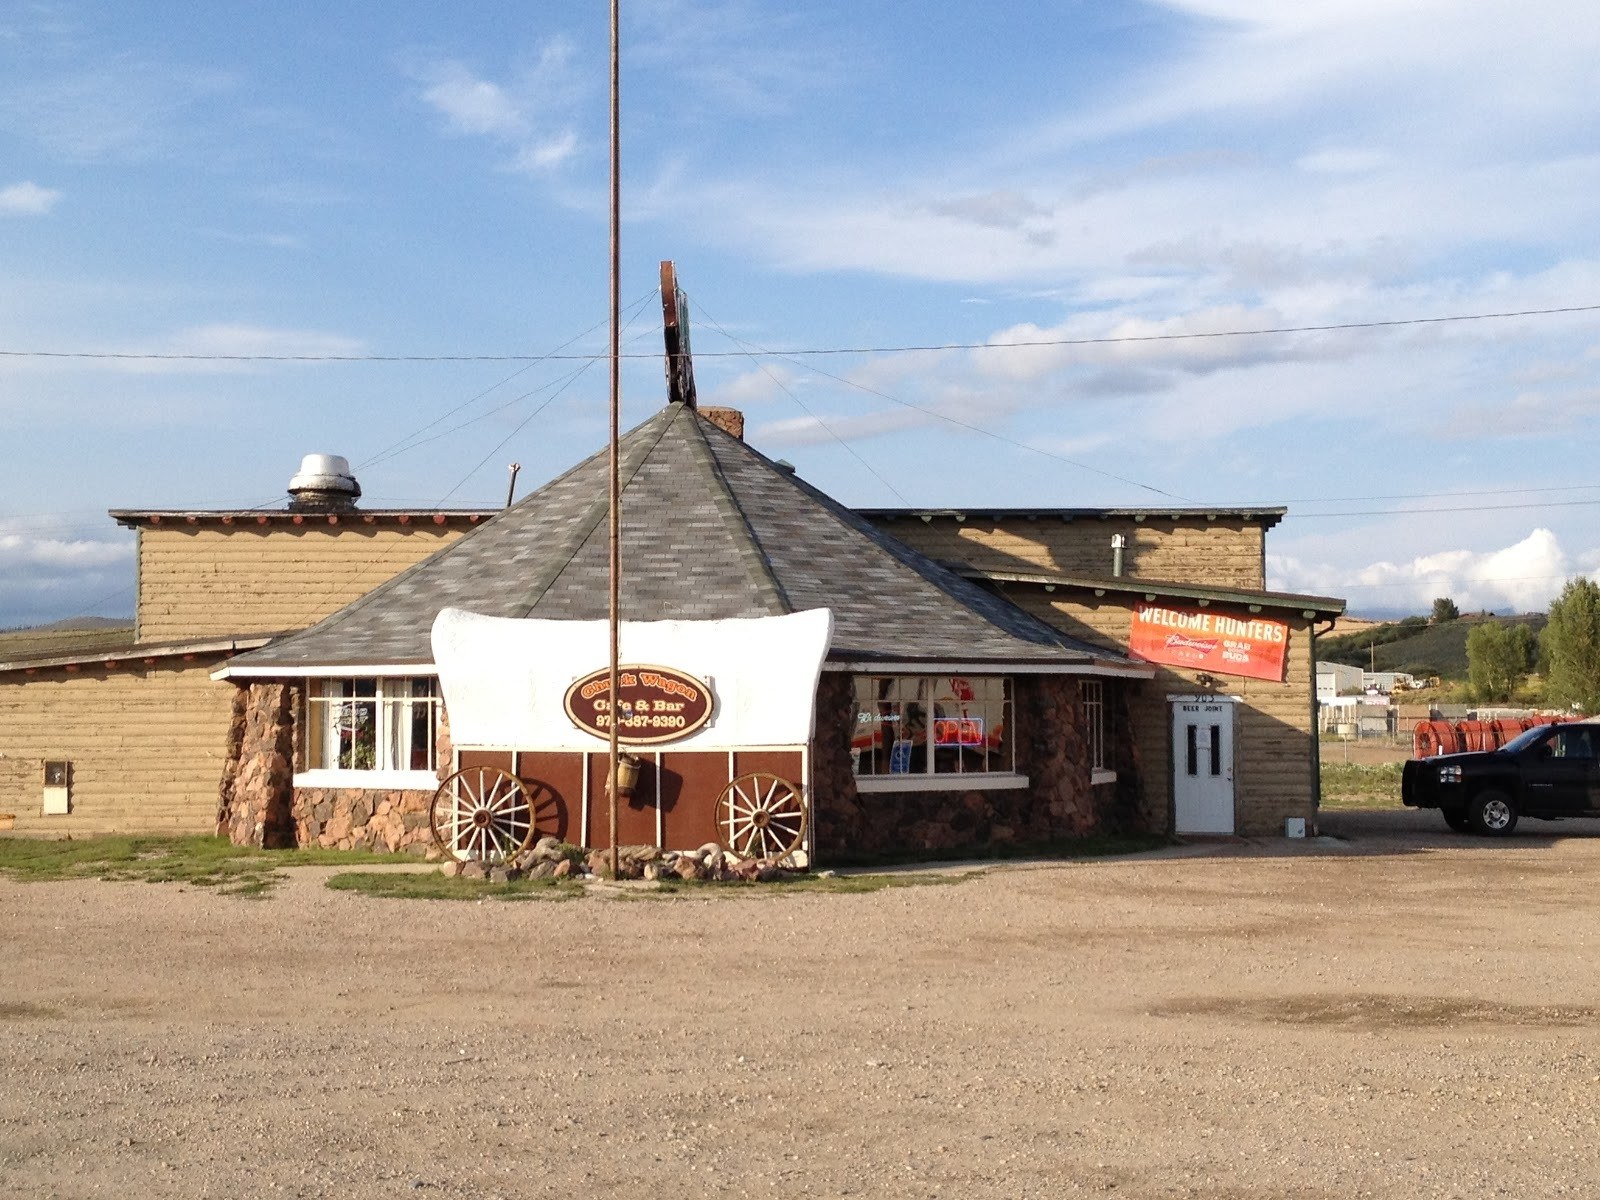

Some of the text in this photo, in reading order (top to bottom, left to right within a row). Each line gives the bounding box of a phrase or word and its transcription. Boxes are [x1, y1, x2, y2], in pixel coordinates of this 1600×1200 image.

[1138, 606, 1283, 643] WELCOME HUNTERS
[581, 672, 698, 702] Chuk Wagon
[593, 699, 685, 711] Cfe & Bar
